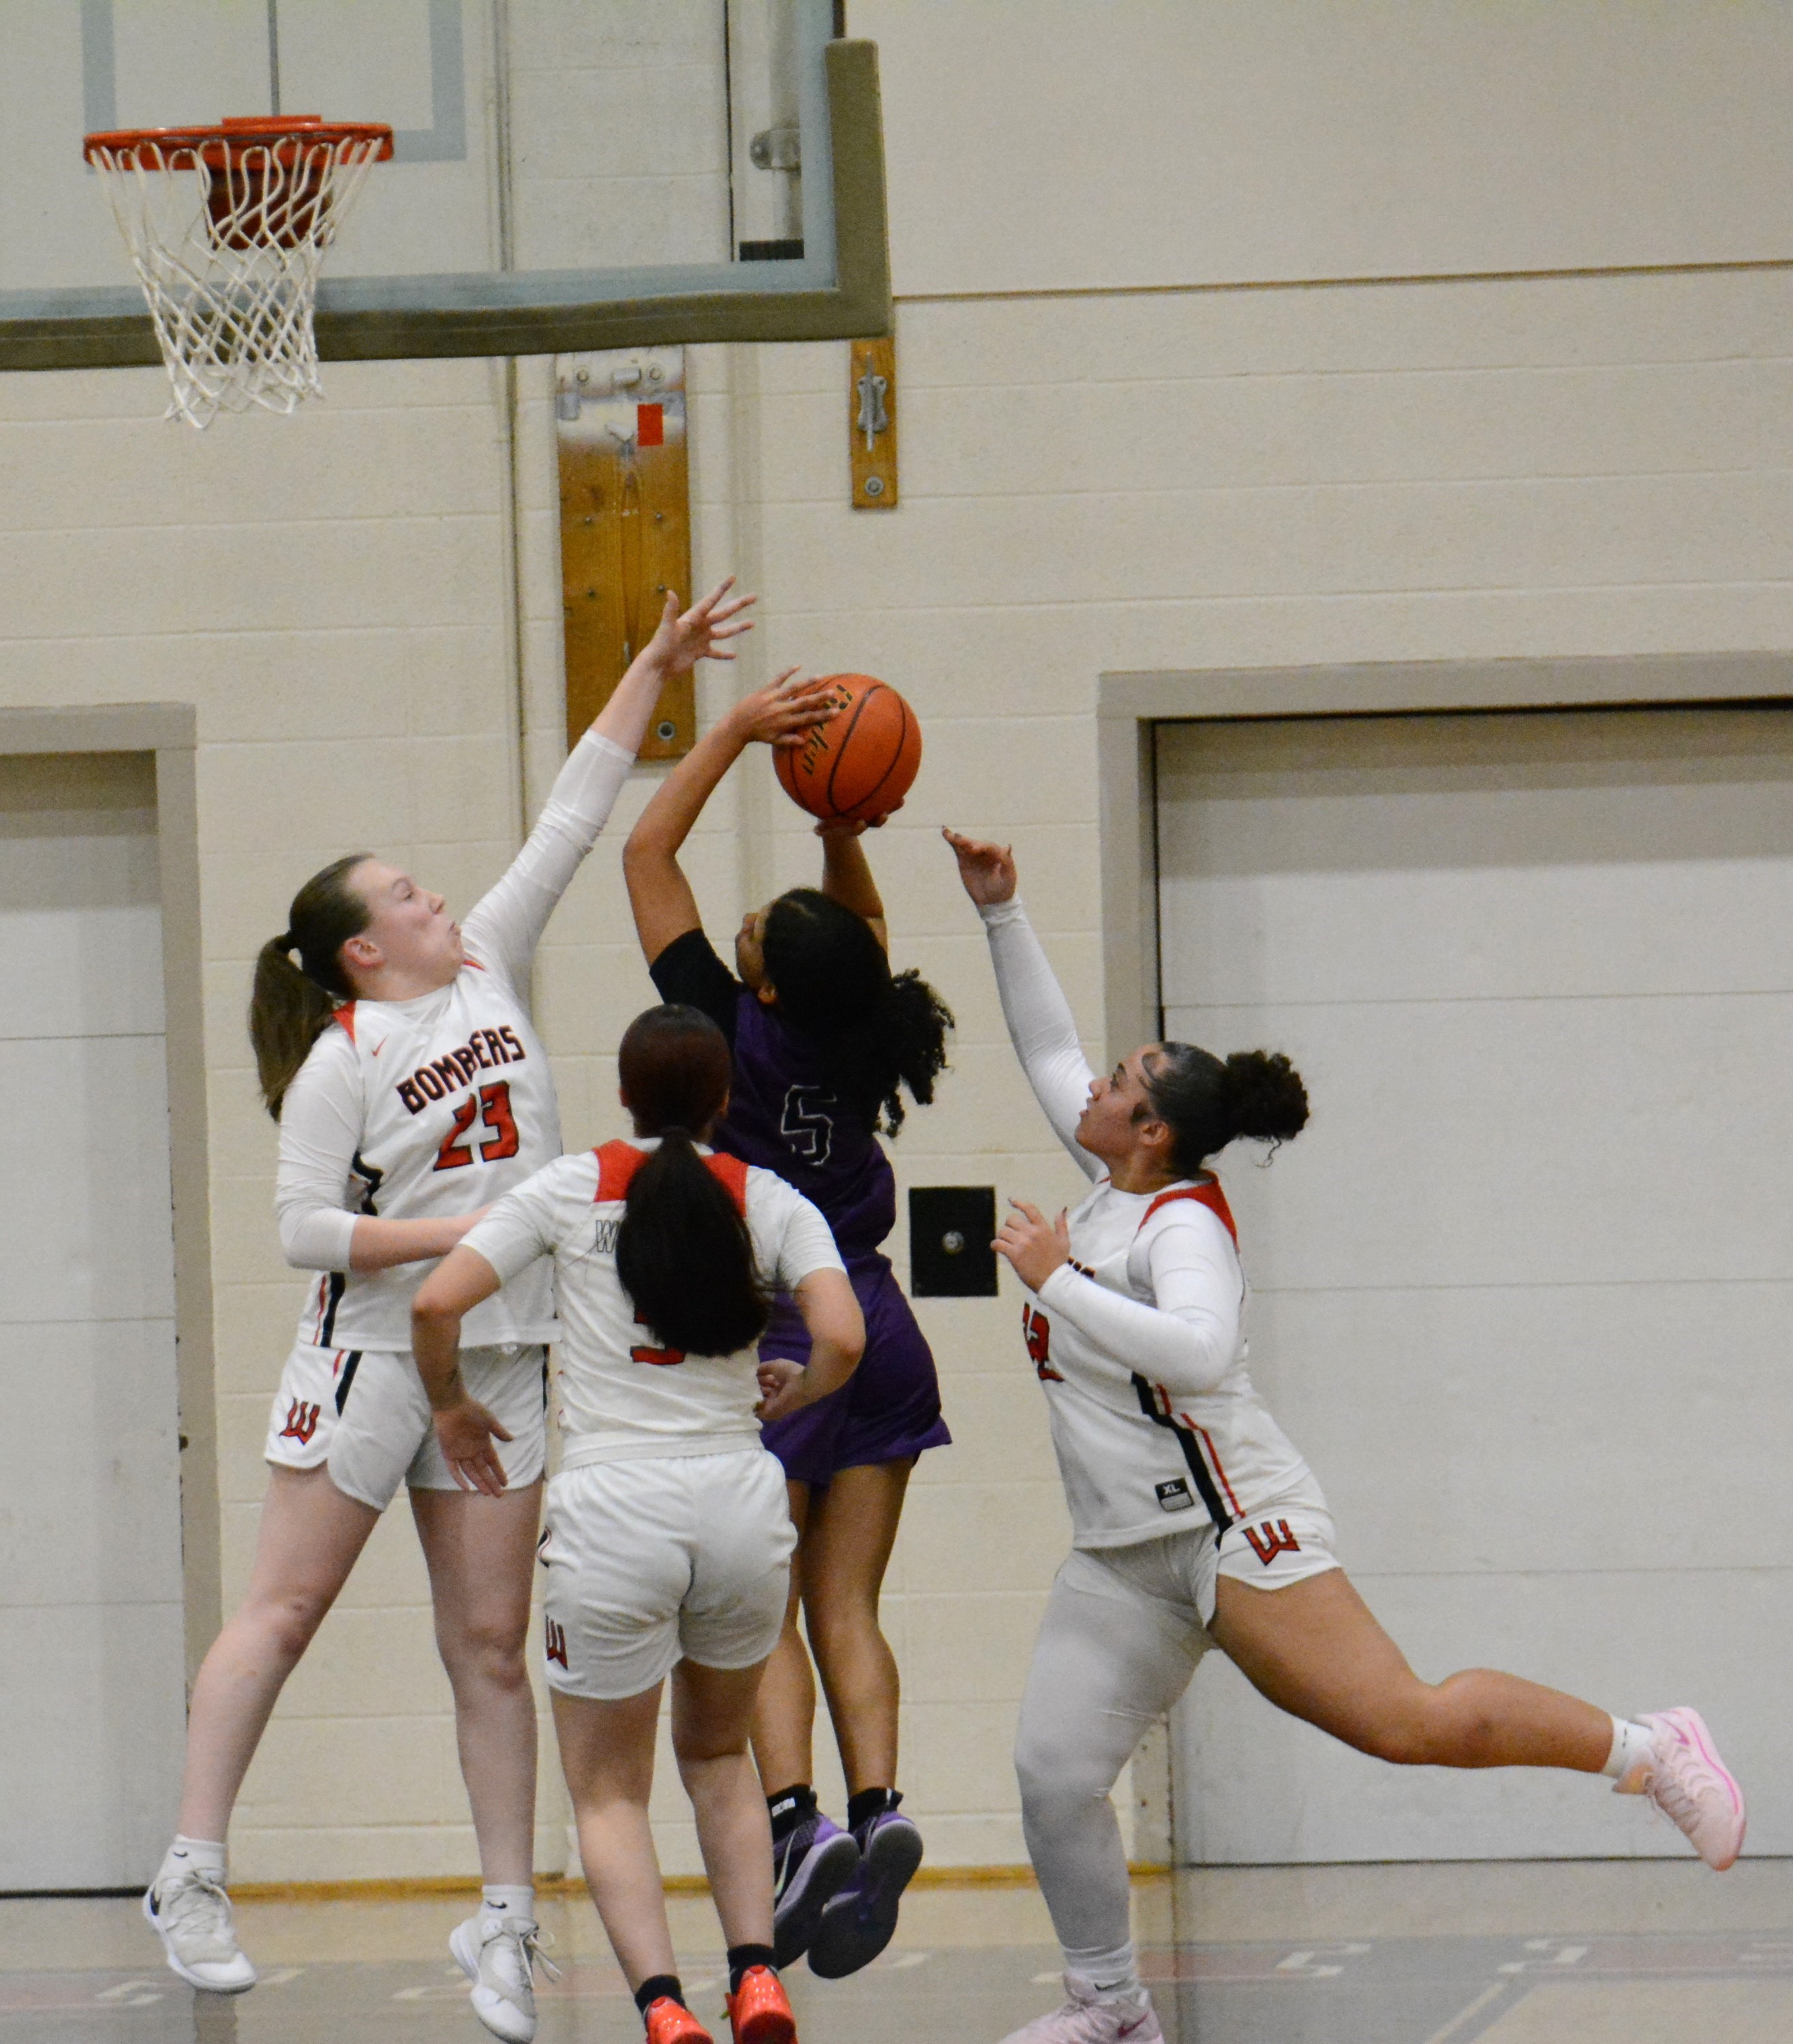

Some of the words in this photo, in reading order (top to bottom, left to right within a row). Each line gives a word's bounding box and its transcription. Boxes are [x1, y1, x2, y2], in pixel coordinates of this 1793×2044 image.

[395, 1025, 526, 1115] BOMBERS
[433, 1079, 519, 1171] 23
[780, 1084, 837, 1166] 5
[1163, 1483, 1181, 1496] XL
